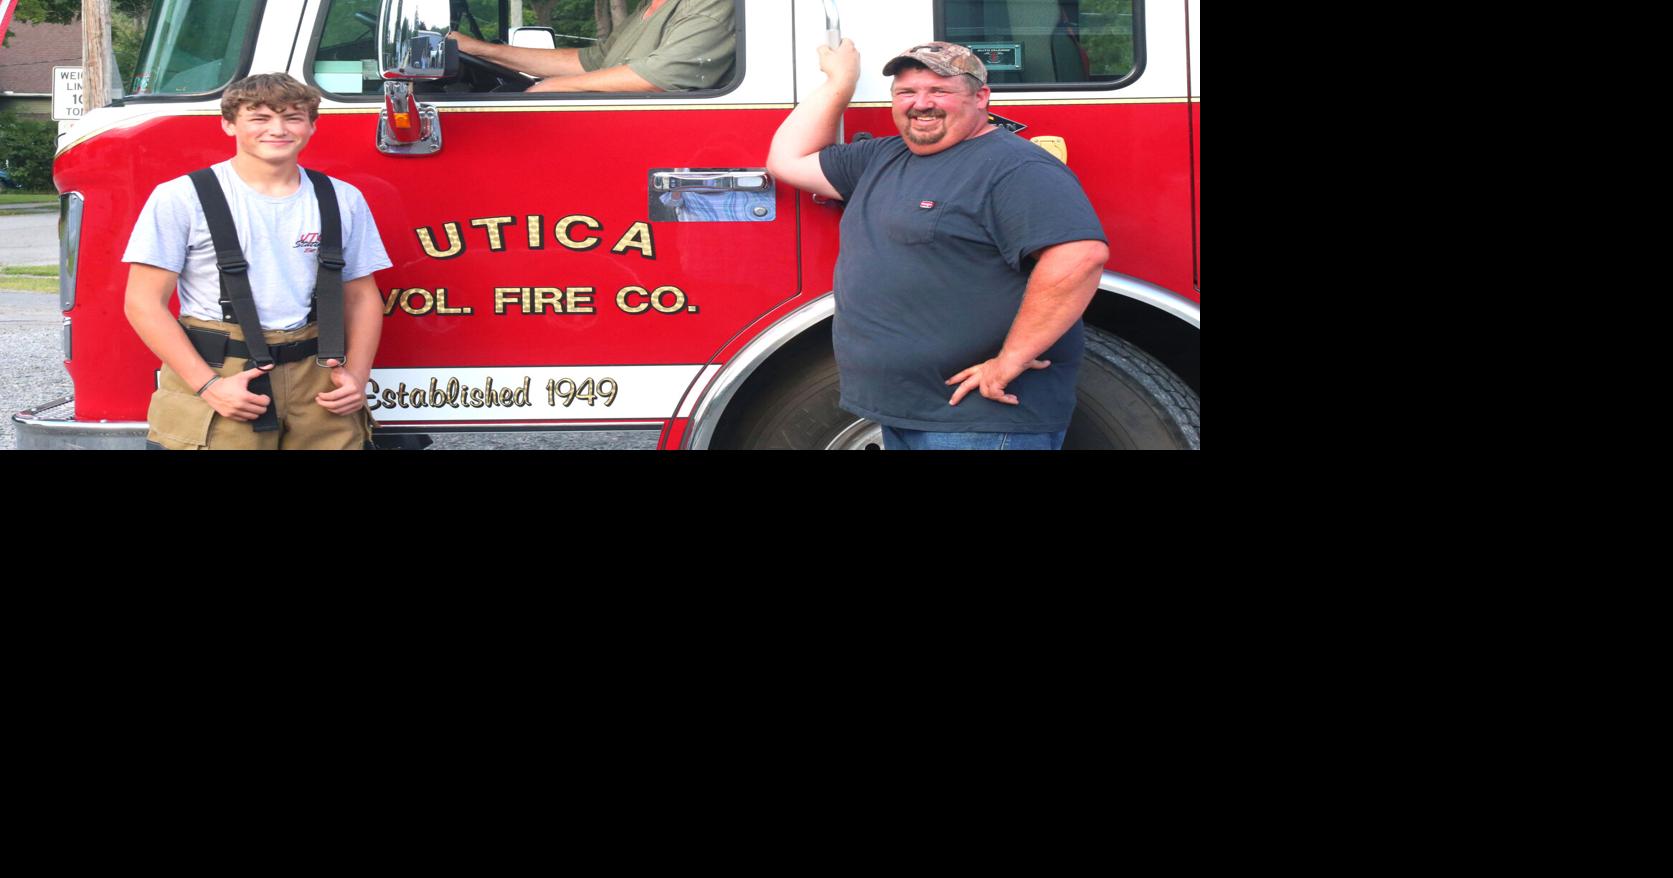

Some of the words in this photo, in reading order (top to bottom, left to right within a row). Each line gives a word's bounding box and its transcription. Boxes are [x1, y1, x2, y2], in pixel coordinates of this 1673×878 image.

[416, 214, 656, 259] UTICA
[493, 286, 595, 315] FIRE
[615, 285, 700, 315] CO.
[364, 376, 532, 411] Established
[545, 376, 619, 408] 1949
